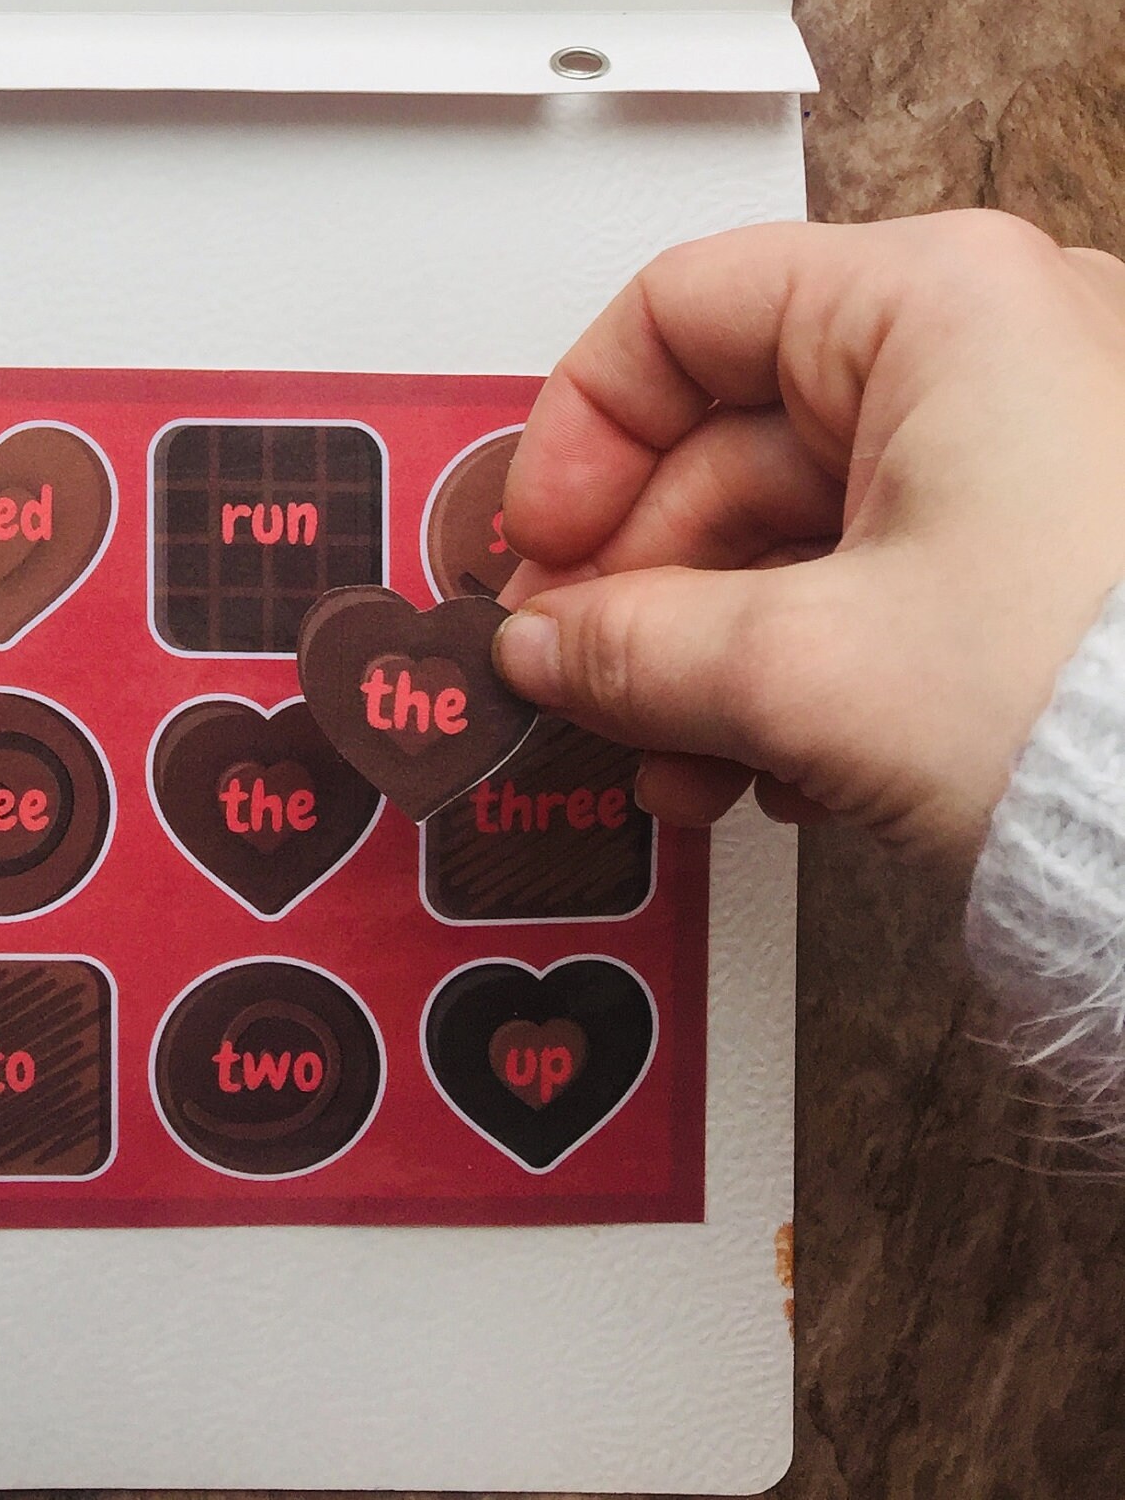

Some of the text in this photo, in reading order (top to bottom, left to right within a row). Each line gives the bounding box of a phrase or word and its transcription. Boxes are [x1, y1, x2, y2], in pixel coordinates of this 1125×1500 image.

[222, 503, 319, 545] run
[361, 667, 466, 734] the
[219, 778, 315, 833] the
[470, 780, 624, 834] three
[213, 1040, 323, 1092] two
[505, 1046, 572, 1102] up
